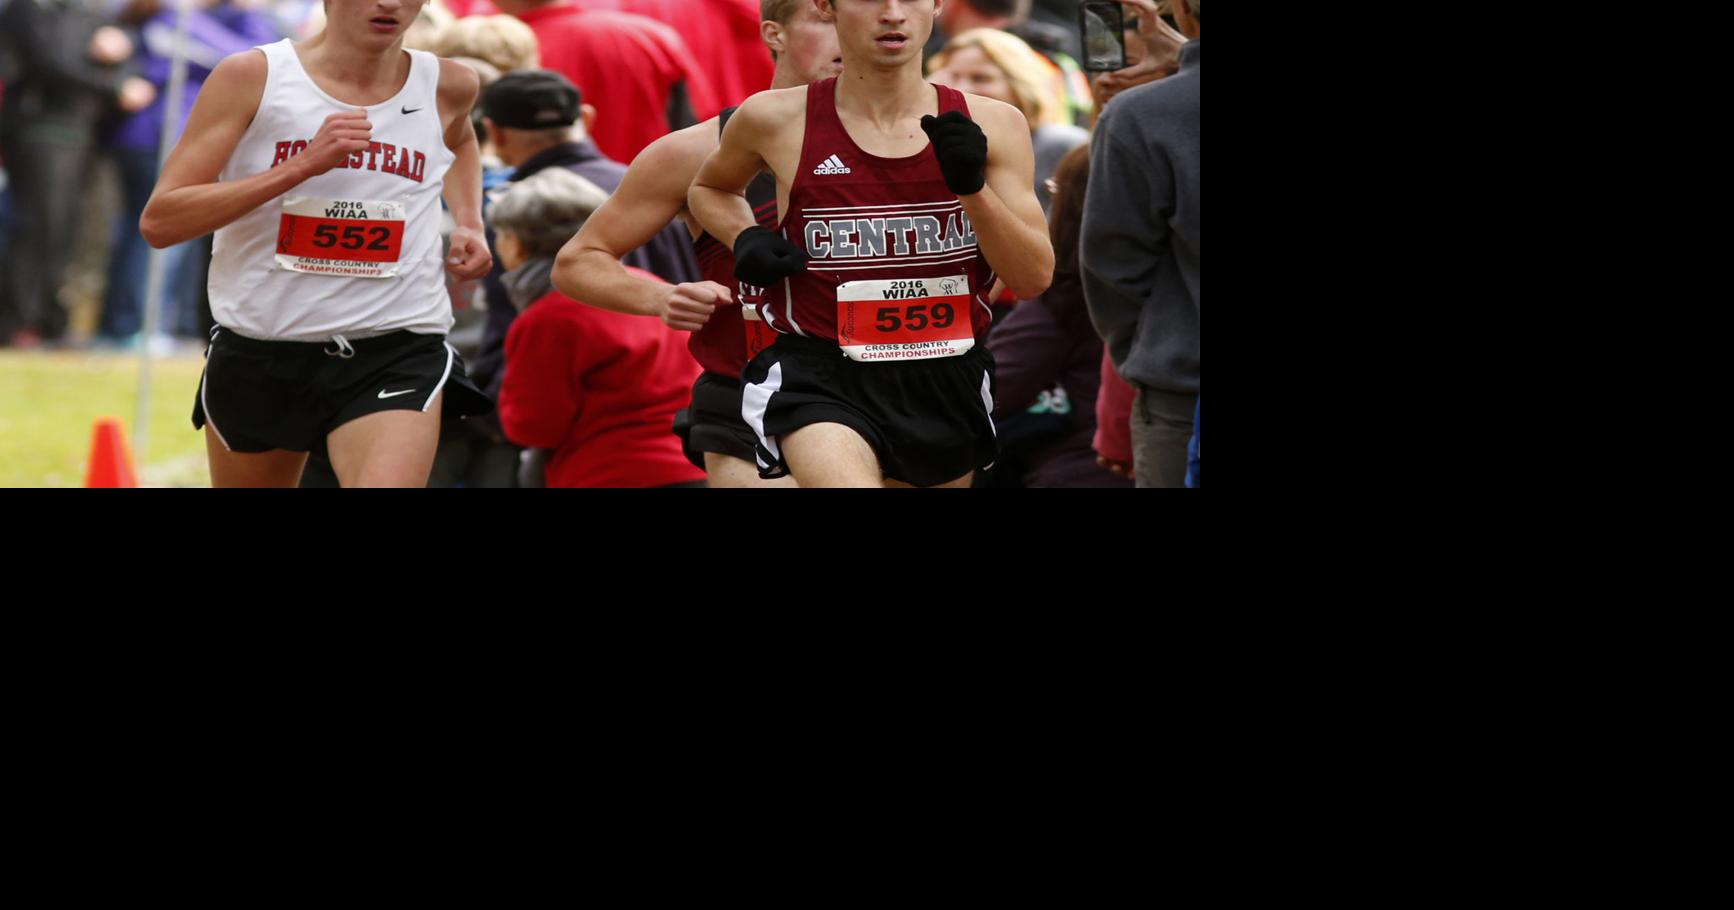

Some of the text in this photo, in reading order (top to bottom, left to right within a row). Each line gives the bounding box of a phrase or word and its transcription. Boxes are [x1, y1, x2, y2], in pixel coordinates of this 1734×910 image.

[813, 166, 851, 175] adidas
[333, 201, 363, 209] 2016
[325, 208, 368, 219] WIAA
[312, 224, 391, 250] 552
[298, 257, 380, 268] CROSS COUNTRY
[293, 263, 382, 275] CHAMPIONSHIPS
[890, 280, 923, 289] 2016
[882, 288, 929, 299] WIAA
[874, 303, 955, 333] 559
[864, 341, 949, 351] CROSS COUNTRY
[860, 347, 956, 360] CHAMPIONSHIPS
